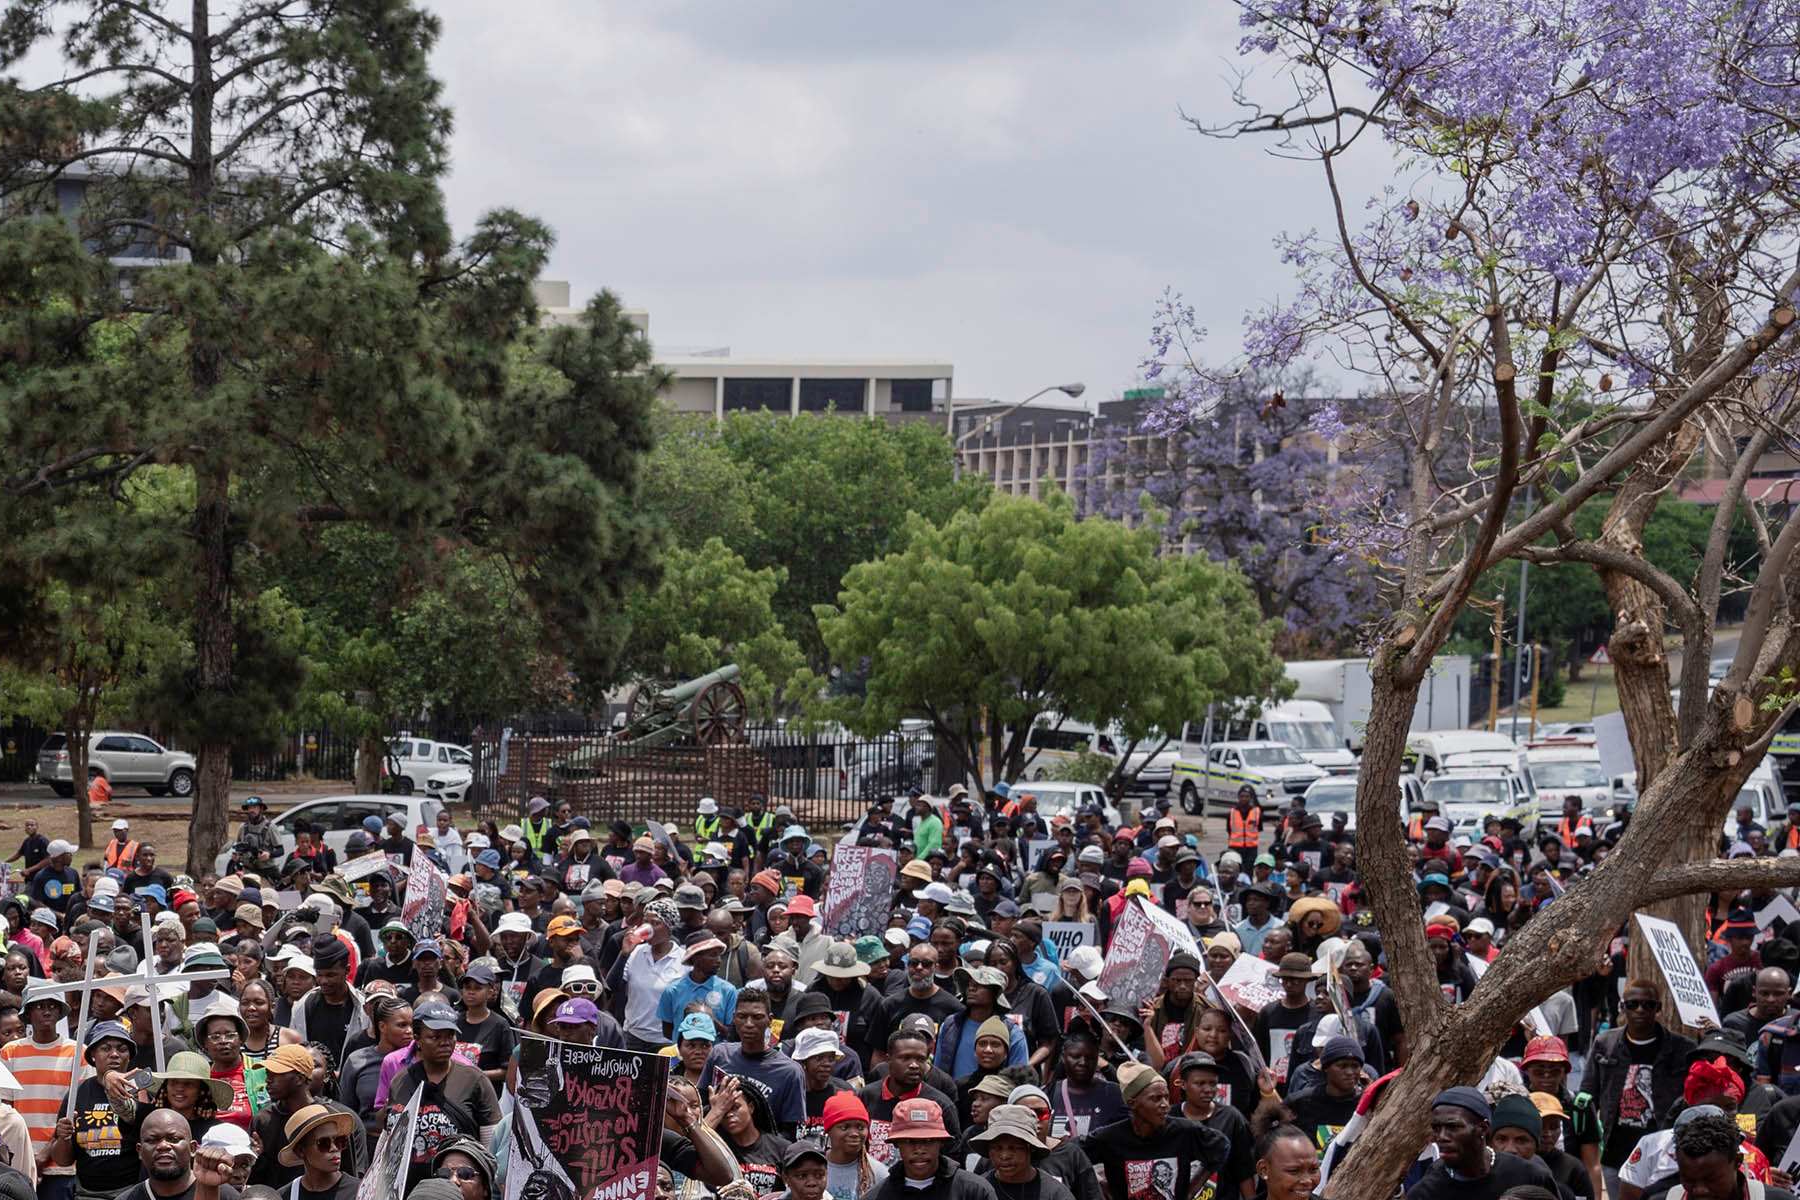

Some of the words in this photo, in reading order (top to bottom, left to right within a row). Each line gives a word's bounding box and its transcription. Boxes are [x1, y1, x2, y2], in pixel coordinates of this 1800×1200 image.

[1050, 931, 1083, 947] WHO
[1650, 928, 1681, 953] WHO
[1656, 949, 1696, 977] KILLED
[565, 1049, 604, 1065] RADEBE
[93, 1103, 110, 1112] JUST
[614, 1112, 639, 1135] NO
